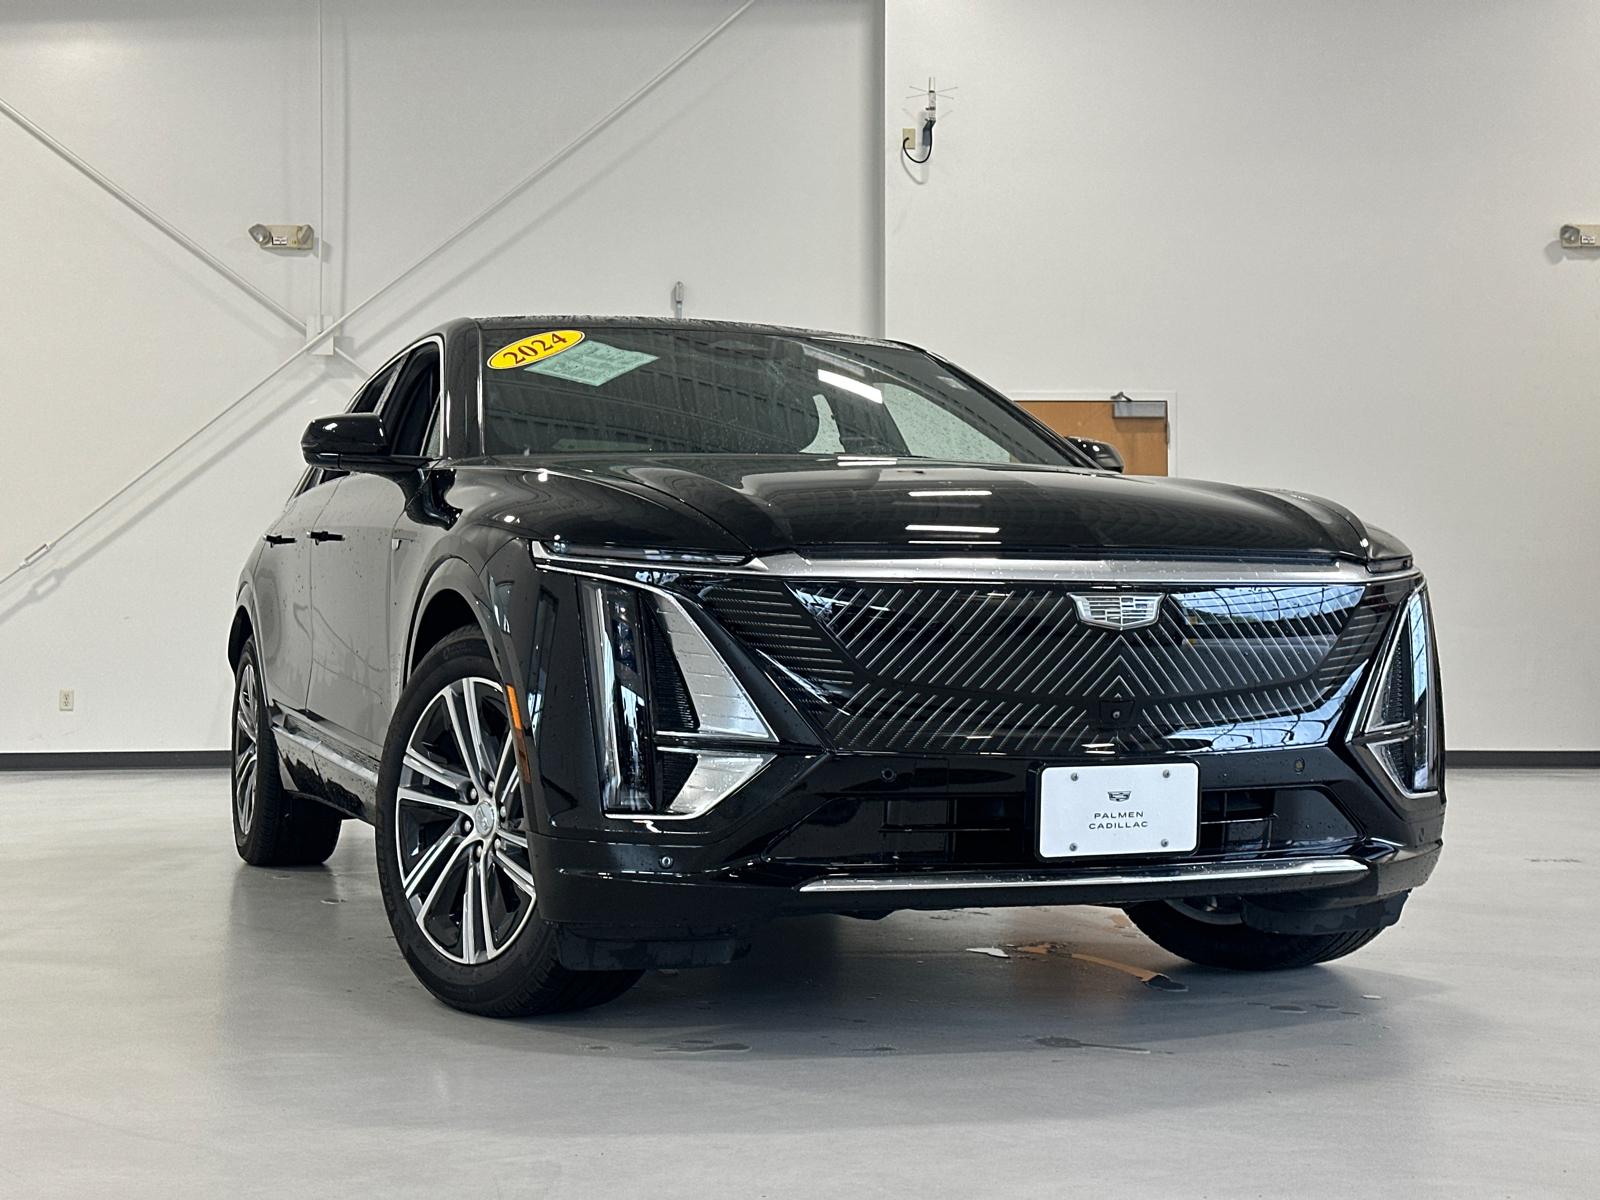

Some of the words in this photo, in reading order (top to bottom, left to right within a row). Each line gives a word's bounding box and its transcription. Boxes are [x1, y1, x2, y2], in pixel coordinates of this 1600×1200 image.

[503, 333, 568, 365] 2024
[1093, 811, 1144, 819] PALMEN
[1088, 820, 1149, 830] CADILLAC
